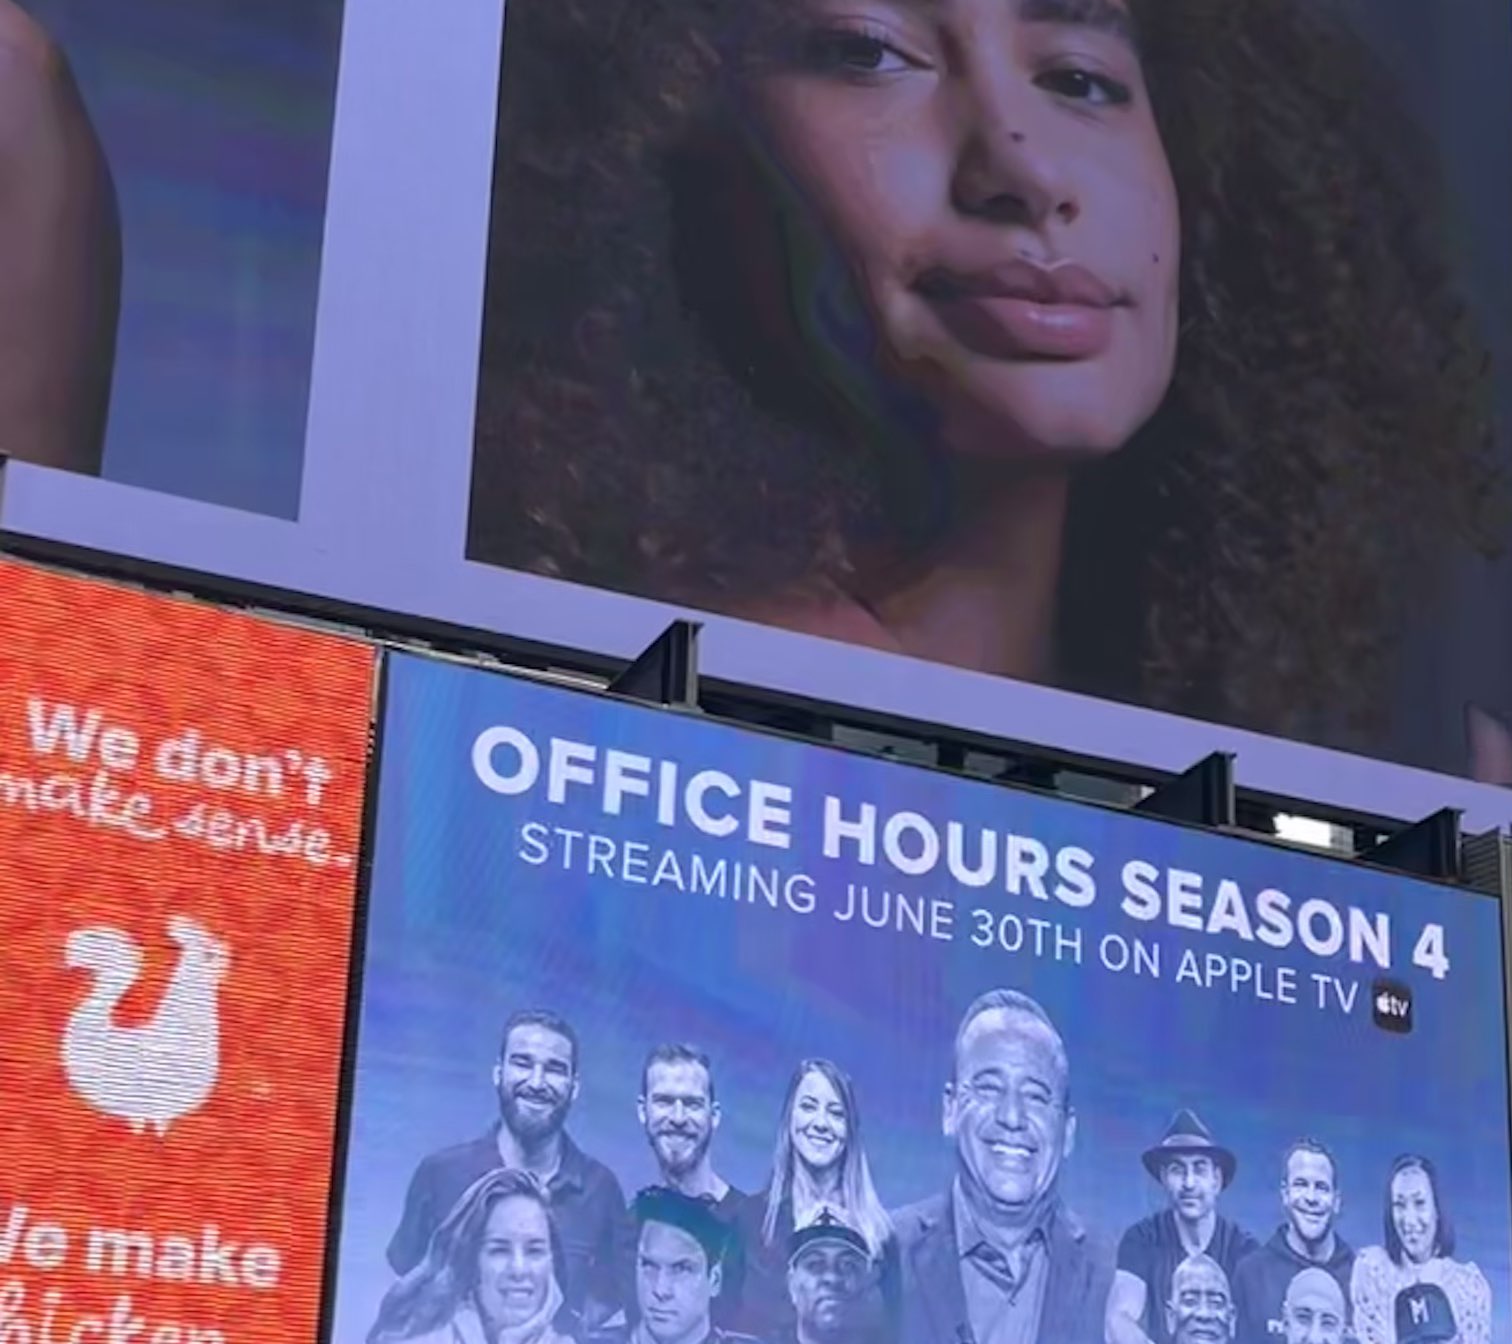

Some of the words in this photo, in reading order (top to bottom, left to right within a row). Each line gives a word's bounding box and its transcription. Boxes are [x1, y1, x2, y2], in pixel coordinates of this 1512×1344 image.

[27, 697, 140, 773] We
[155, 728, 334, 806] don't
[173, 802, 353, 868] sense.
[471, 725, 793, 849] OFFICE
[822, 795, 1096, 907] HOURS
[1121, 861, 1392, 968] SEASON
[1412, 923, 1449, 980] 4
[519, 822, 817, 915] STREAMING
[833, 883, 954, 941] JUNE
[970, 908, 1082, 964] 30TH
[1100, 933, 1160, 978] ON
[1175, 949, 1297, 1004] APPLE
[1311, 973, 1359, 1014] TV
[88, 1224, 282, 1289] make
